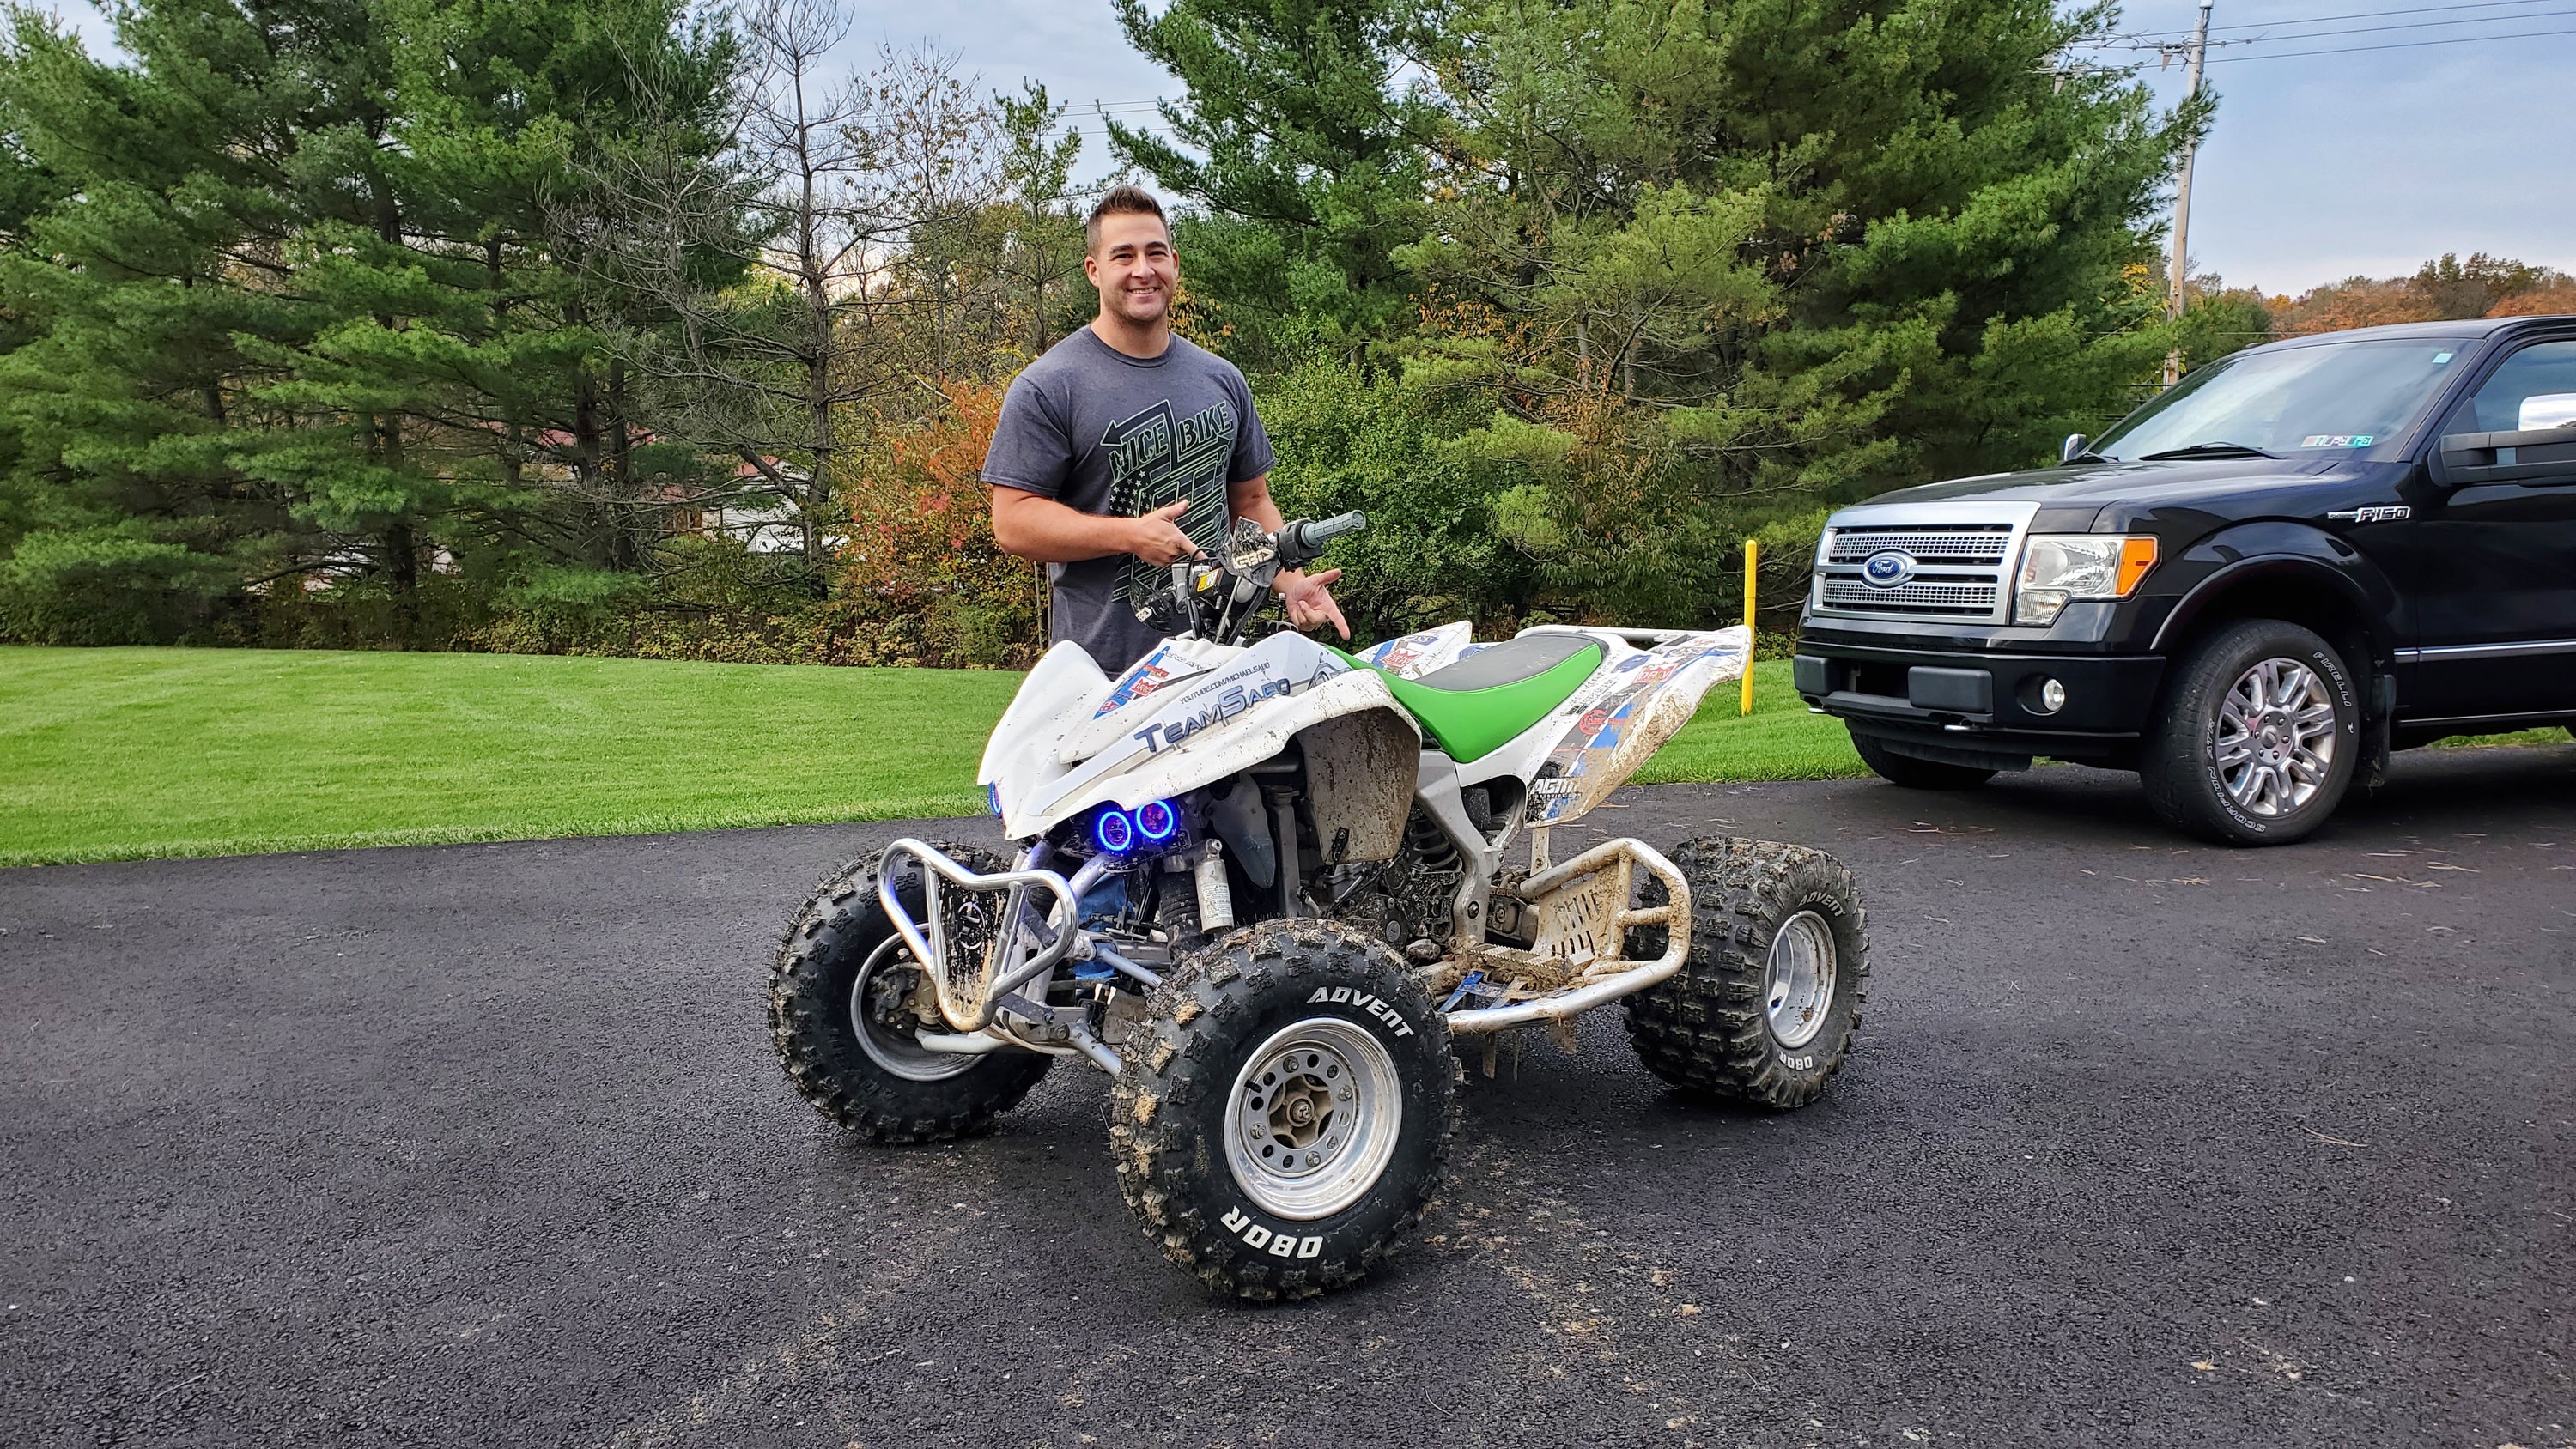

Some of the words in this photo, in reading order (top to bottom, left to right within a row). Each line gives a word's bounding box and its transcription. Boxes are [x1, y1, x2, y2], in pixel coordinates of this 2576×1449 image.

[1109, 420, 1169, 482] NICE
[1179, 400, 1234, 452] BIKE
[1872, 560, 1894, 573] Ford
[2313, 652, 2352, 707] PIRELLI
[2206, 718, 2215, 759] ATR
[2208, 766, 2267, 833] SCORPION
[1798, 891, 1845, 917] ADVENT
[1307, 987, 1415, 1038] ADVENT
[1779, 1052, 1814, 1070] OBOR
[1220, 1205, 1323, 1258] OBOR
